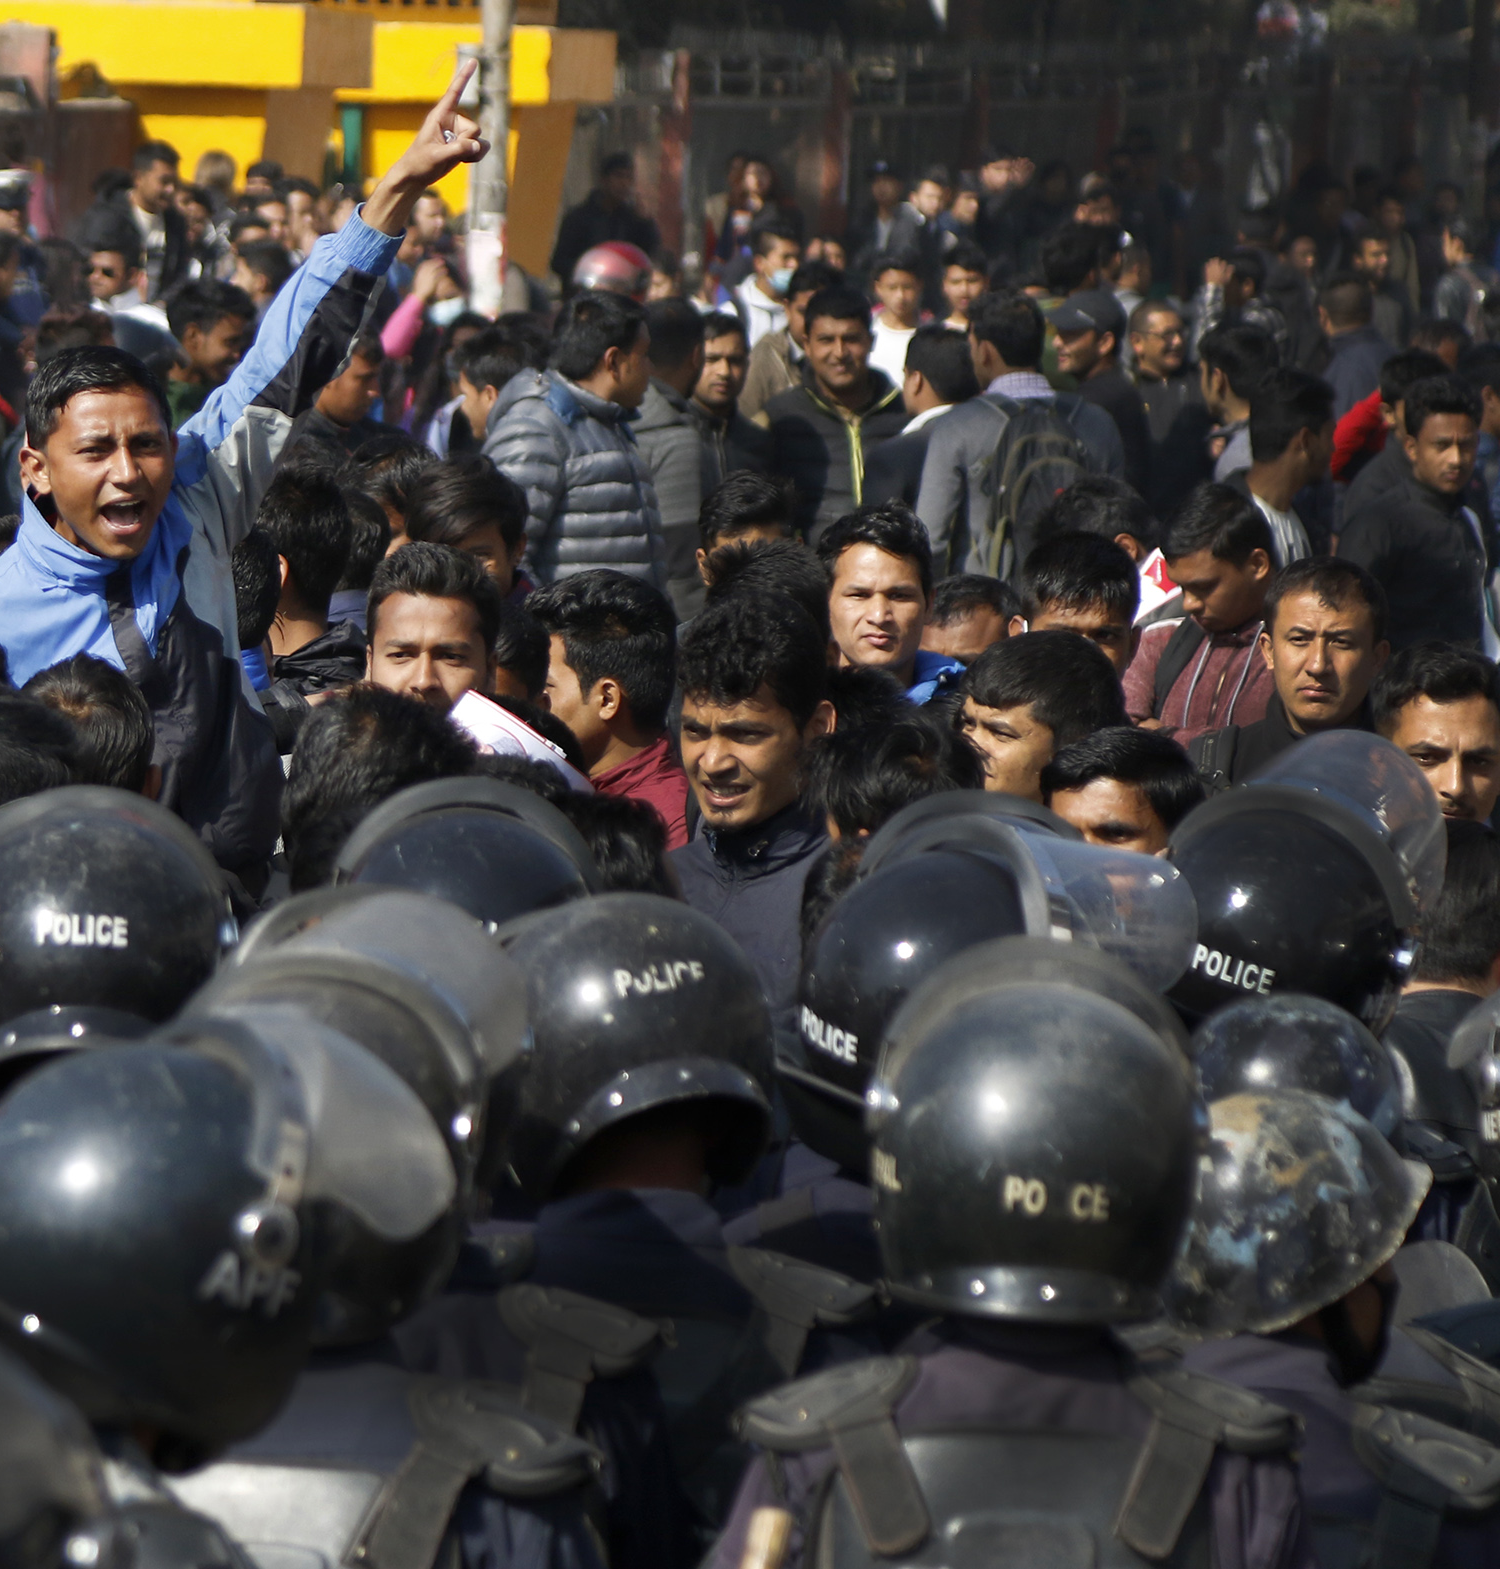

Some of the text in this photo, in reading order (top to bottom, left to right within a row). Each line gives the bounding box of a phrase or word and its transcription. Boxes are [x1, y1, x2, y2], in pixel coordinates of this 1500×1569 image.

[35, 908, 128, 948] POLICE
[1191, 943, 1276, 996] POLICE
[801, 1003, 859, 1064] POLICE
